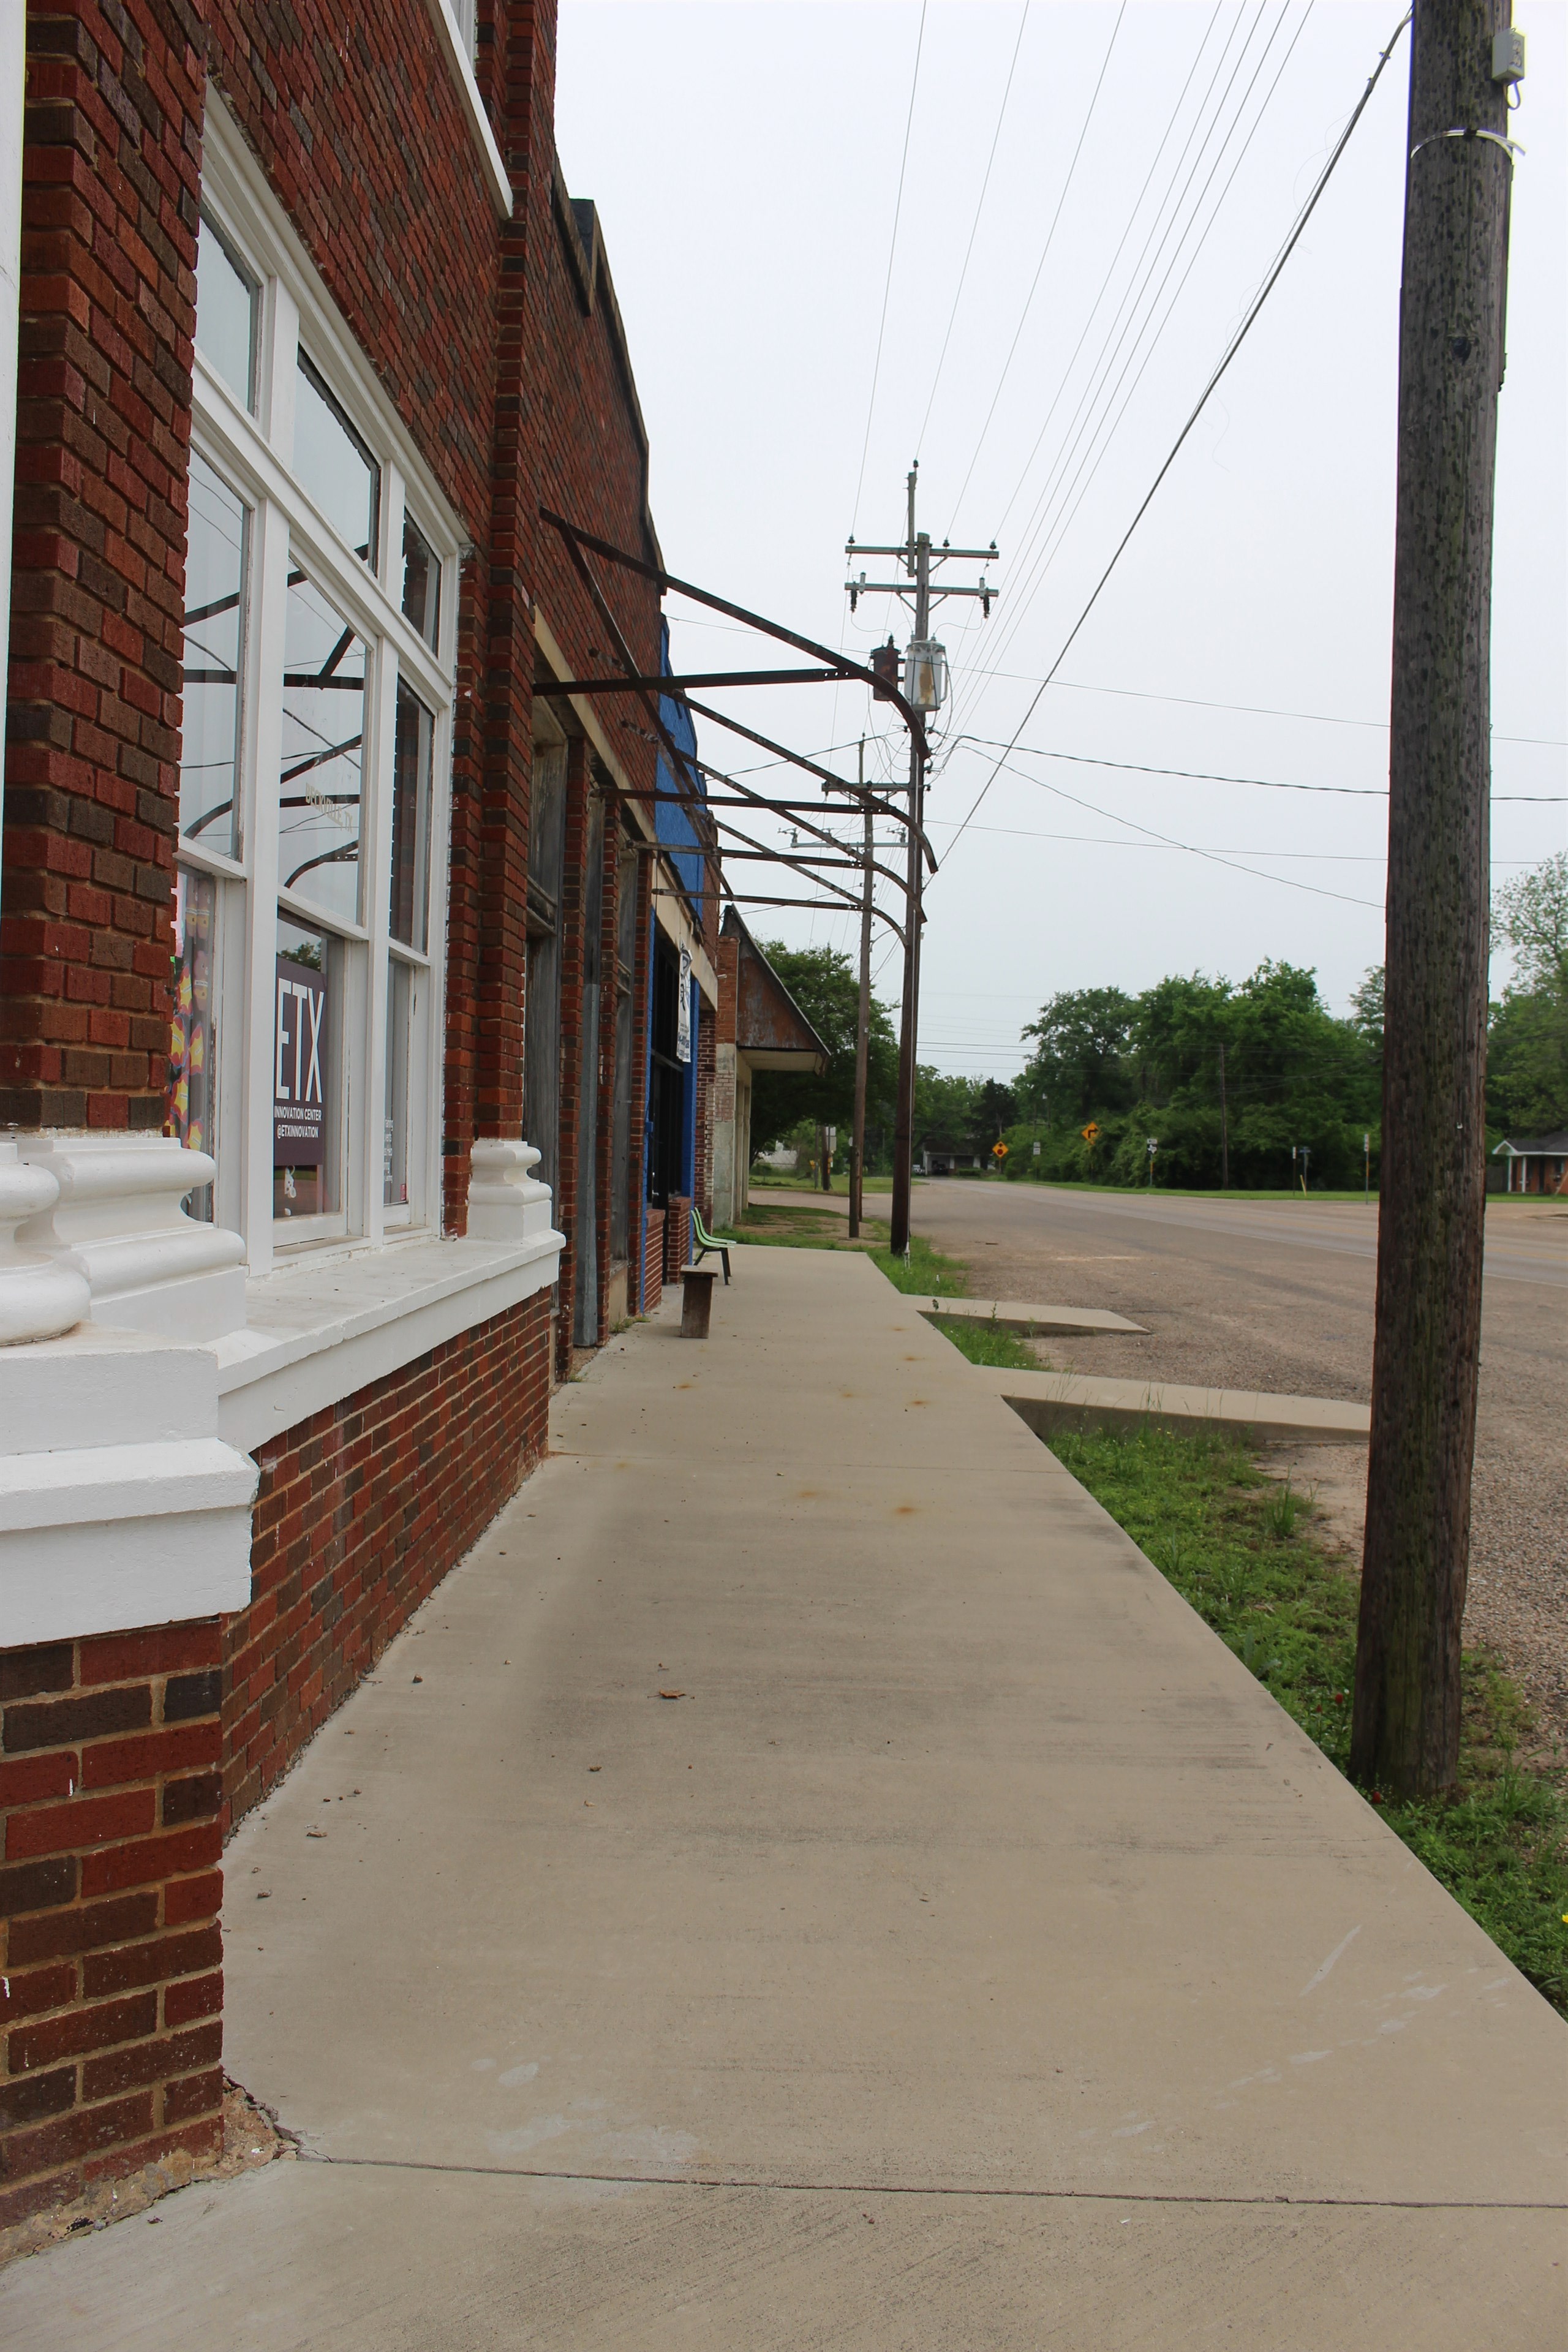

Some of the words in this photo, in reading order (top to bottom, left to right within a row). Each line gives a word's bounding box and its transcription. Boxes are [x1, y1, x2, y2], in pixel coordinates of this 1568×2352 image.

[276, 977, 324, 1103] ETX
[274, 1106, 304, 1120] INNOVATION
[304, 1108, 322, 1121] CENTER
[277, 1124, 318, 1139] @ETXINNOVATION
